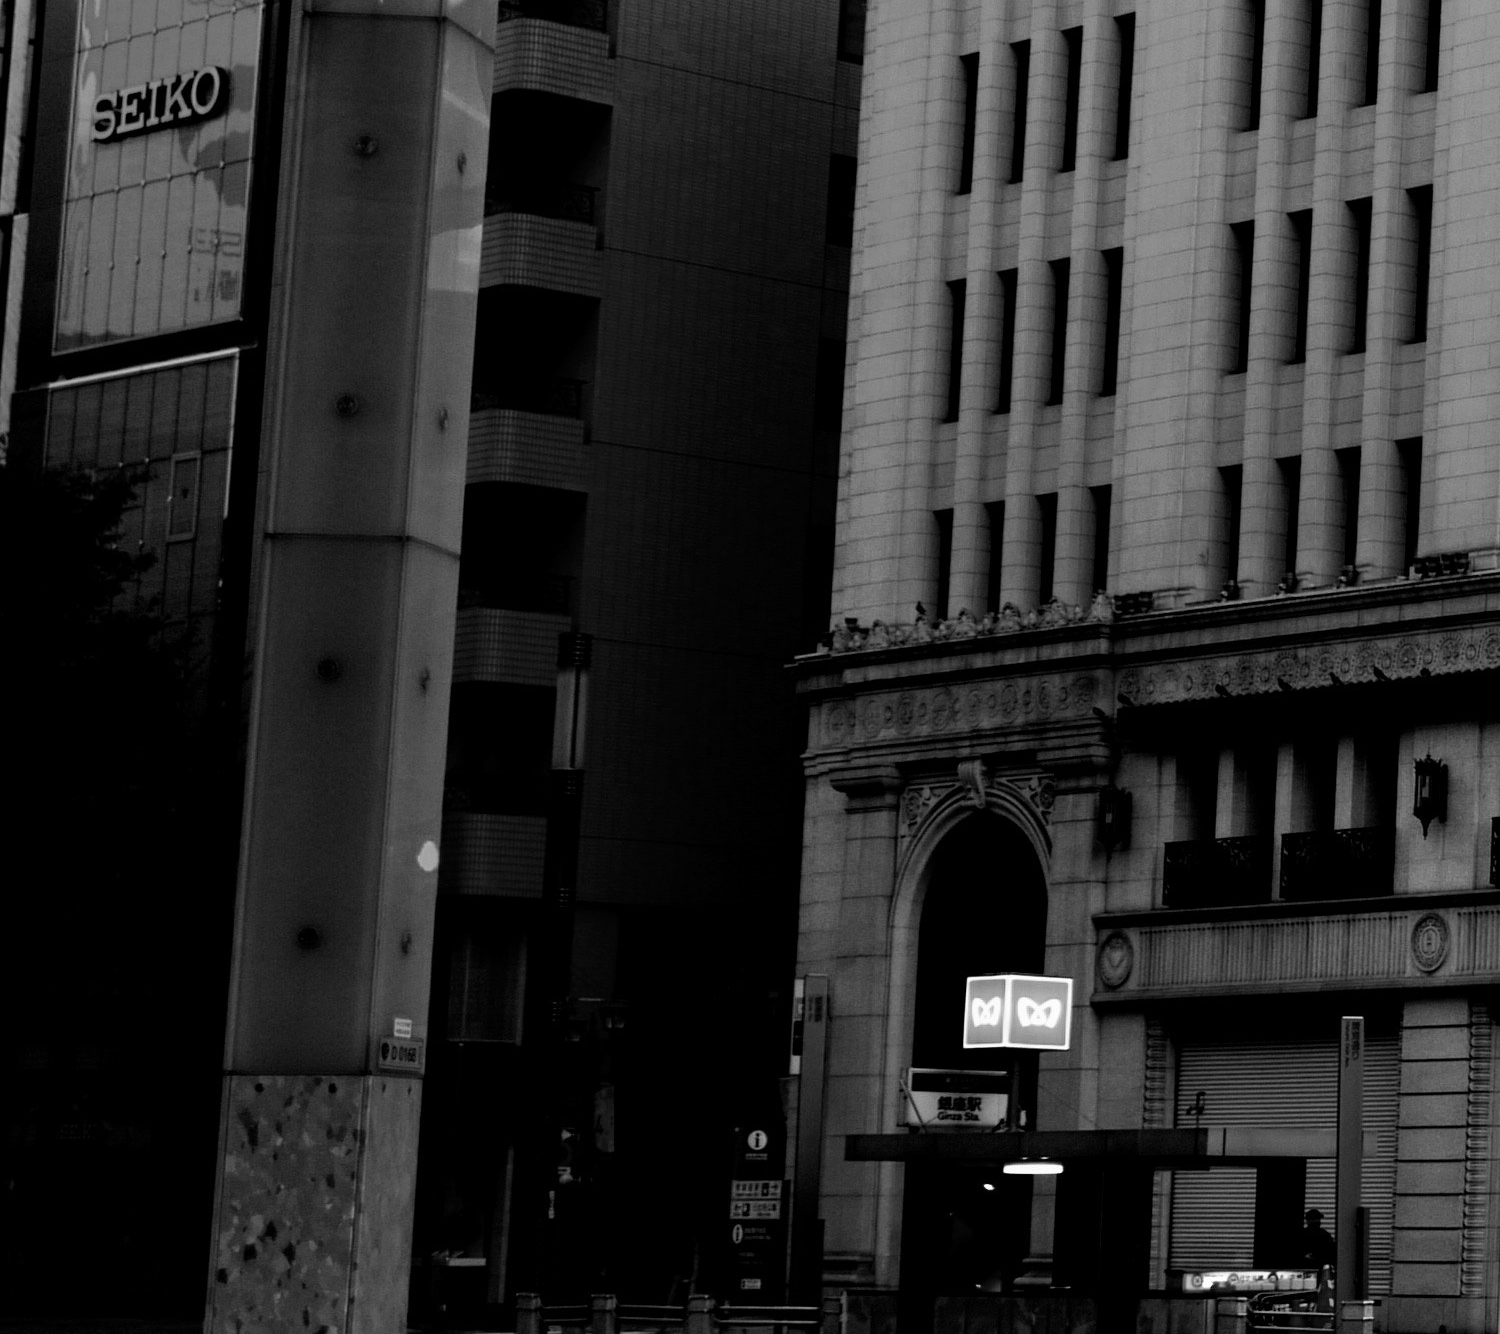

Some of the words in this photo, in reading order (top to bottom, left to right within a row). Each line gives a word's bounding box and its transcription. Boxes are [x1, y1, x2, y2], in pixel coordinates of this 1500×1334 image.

[92, 66, 222, 140] SEIKO
[938, 1096, 982, 1111] 銀座駅
[937, 1111, 962, 1121] Ginza
